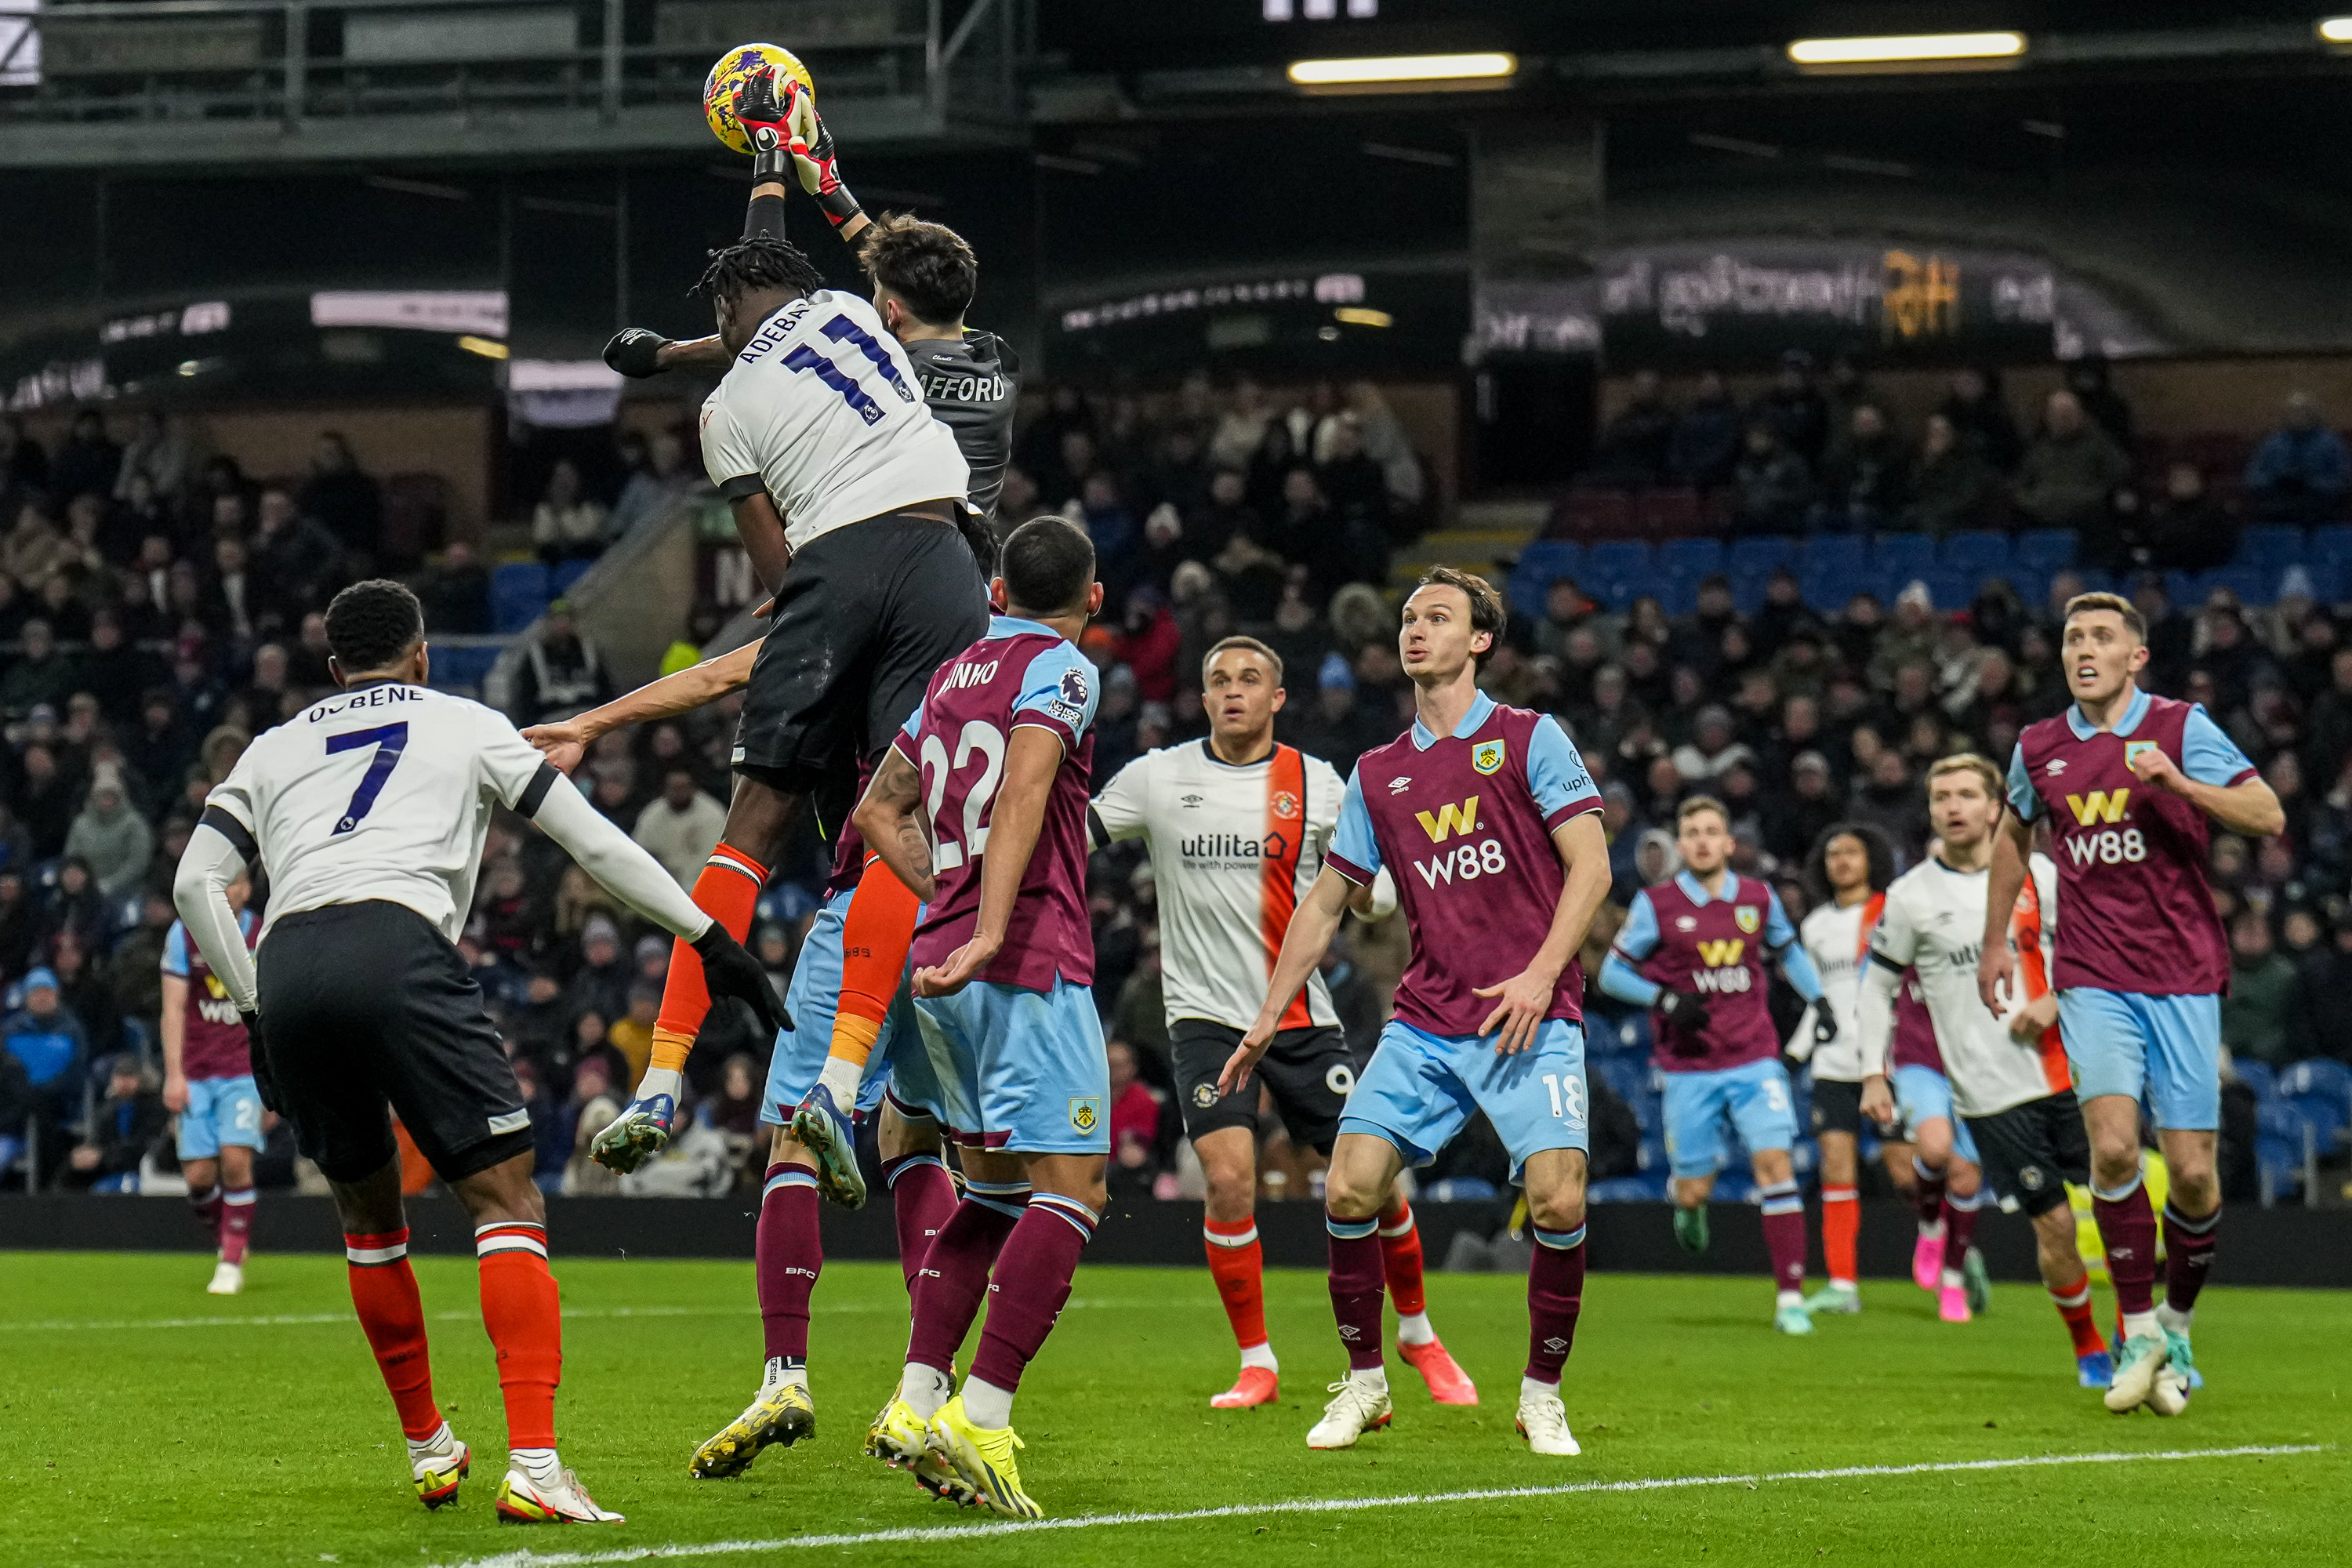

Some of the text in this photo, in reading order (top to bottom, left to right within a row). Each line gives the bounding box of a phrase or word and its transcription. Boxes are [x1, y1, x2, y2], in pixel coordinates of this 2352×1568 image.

[739, 301, 811, 365] ADEBA
[779, 313, 916, 427] 11
[1051, 699, 1064, 712] No
[325, 720, 408, 837] 7
[1563, 774, 1595, 792] uph
[920, 720, 1006, 876] 22
[1181, 834, 1259, 858] utilita
[1413, 839, 1506, 890] W88
[2065, 829, 2147, 866] W88
[1692, 964, 1751, 994] W88
[198, 999, 242, 1025] W8
[1326, 1064, 1356, 1102] 9
[1542, 1073, 1587, 1122] 18
[785, 1267, 816, 1279] BFC
[917, 1268, 941, 1278] FC
